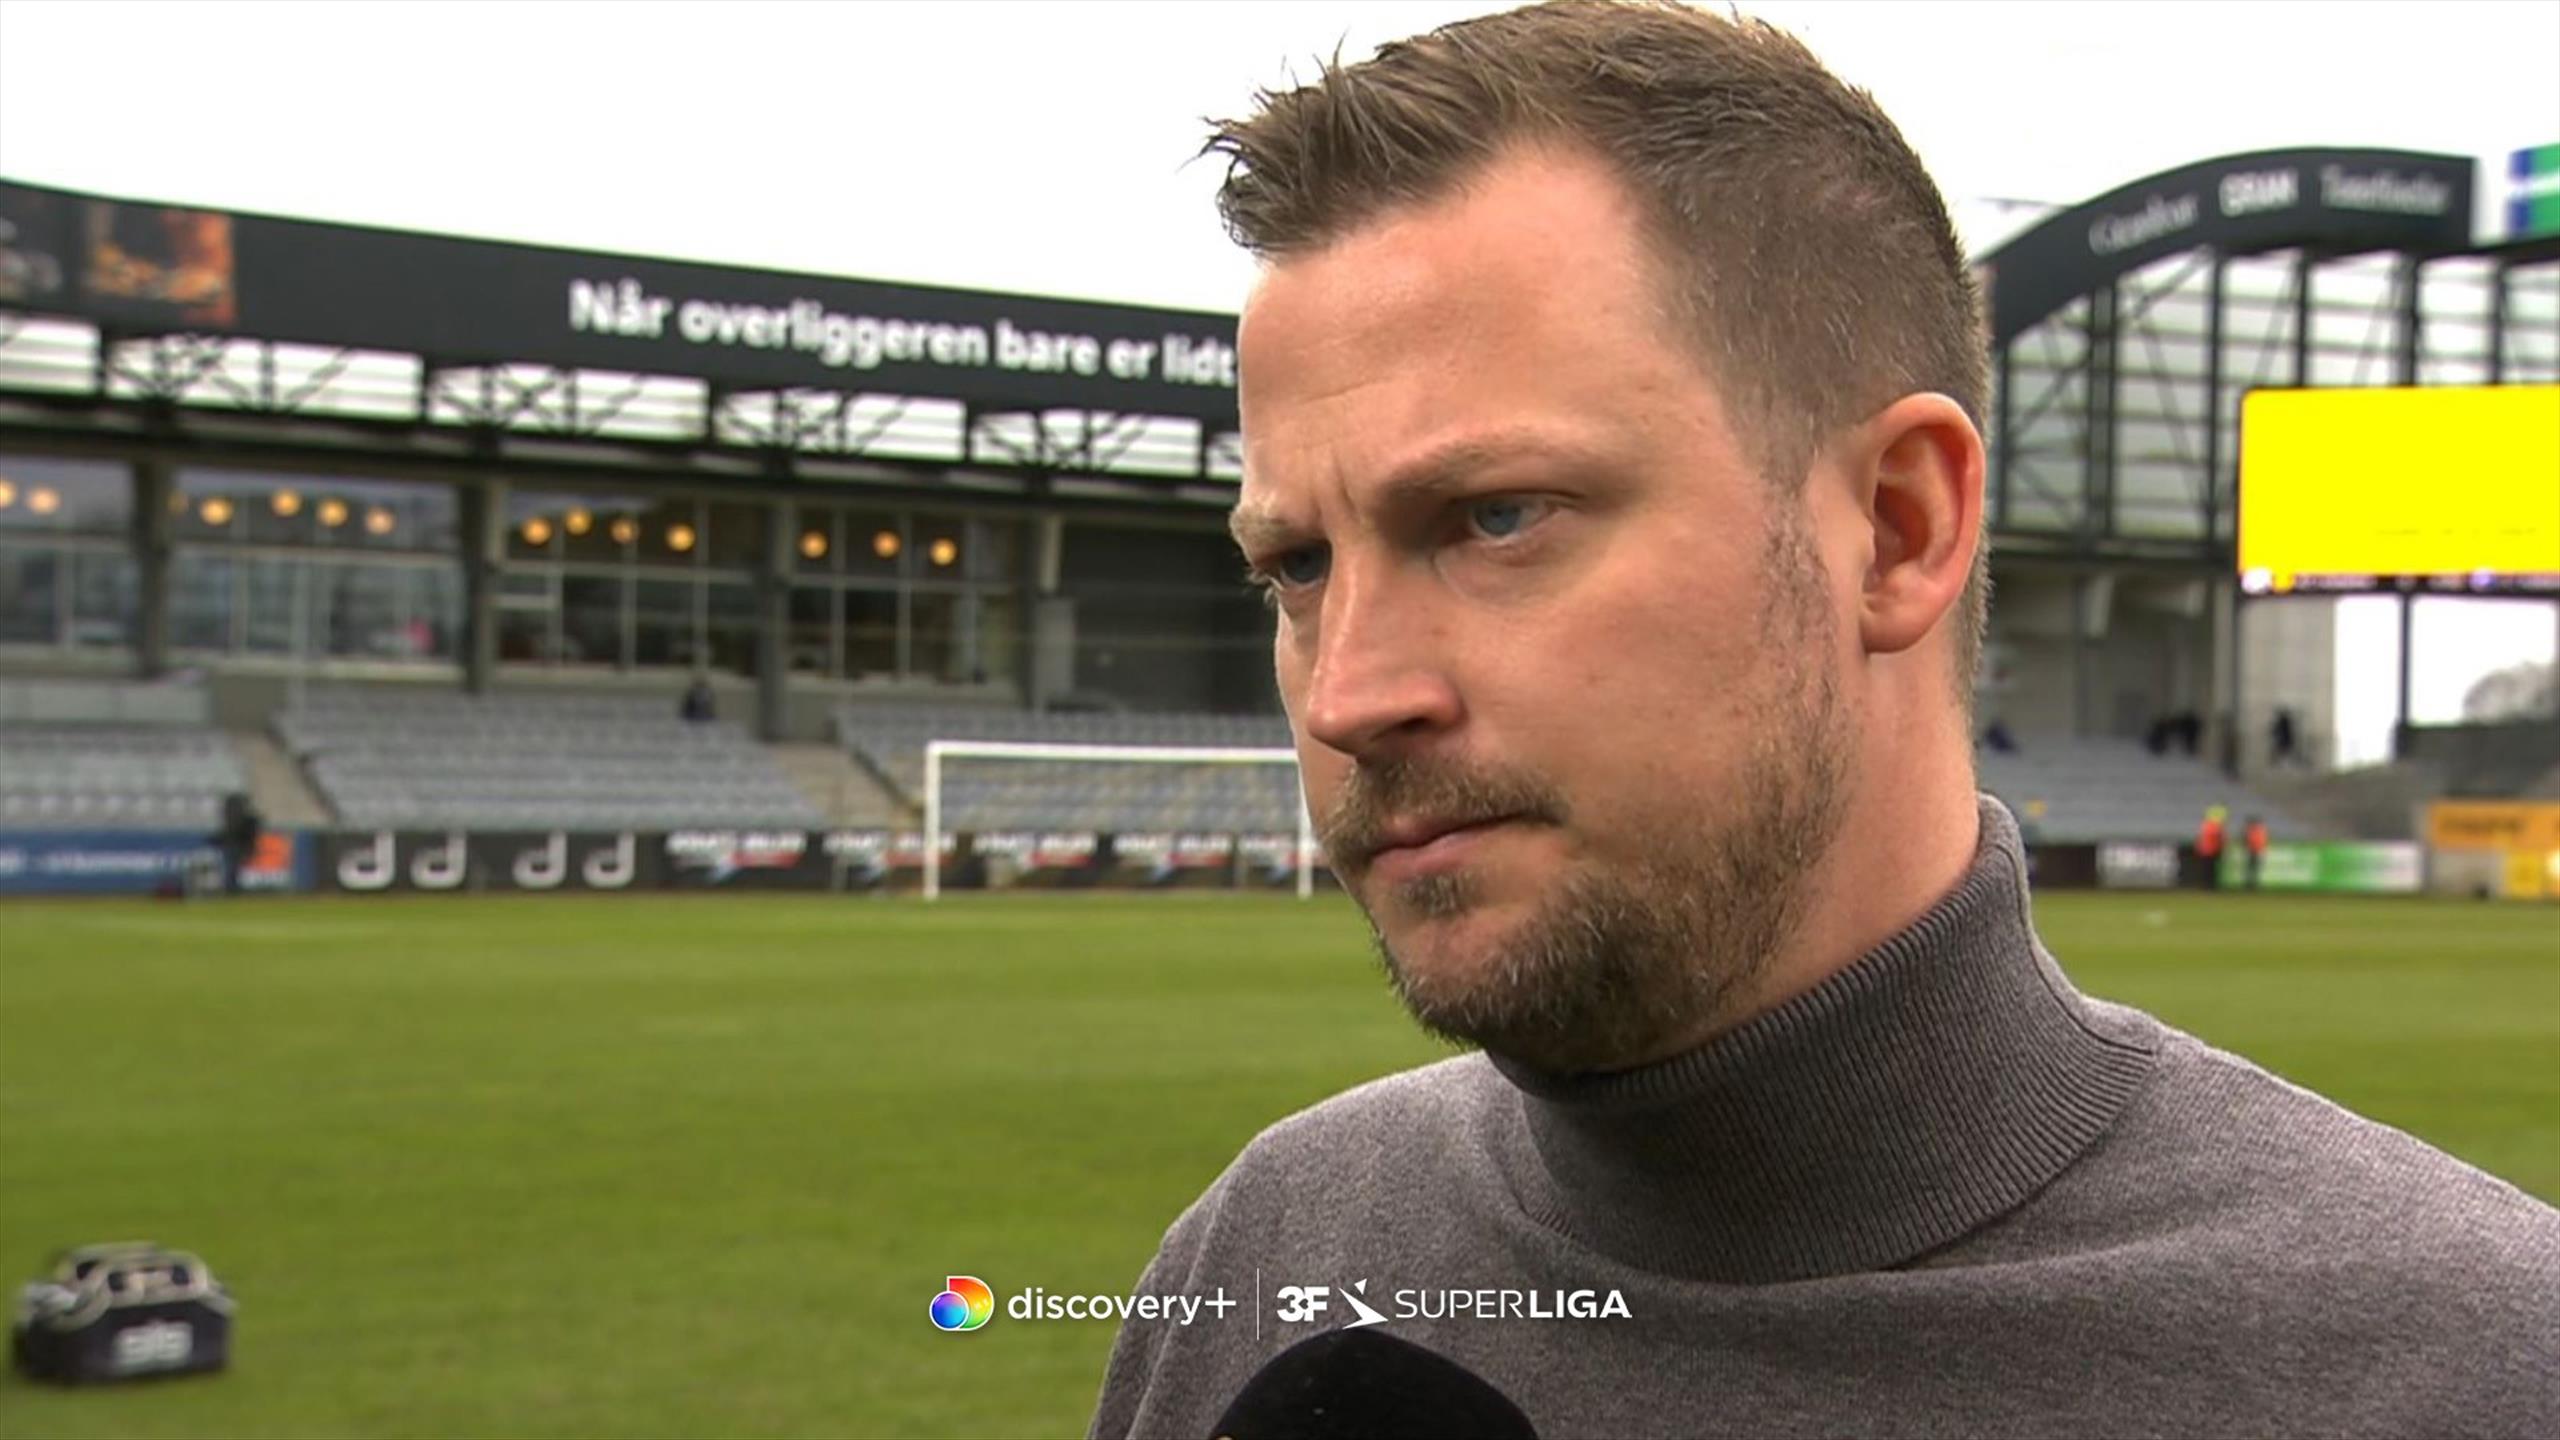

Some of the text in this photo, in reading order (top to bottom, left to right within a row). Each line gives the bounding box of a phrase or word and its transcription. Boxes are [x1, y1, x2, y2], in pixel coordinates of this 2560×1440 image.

[569, 279, 1236, 387] Når overliggeren bare er lidt
